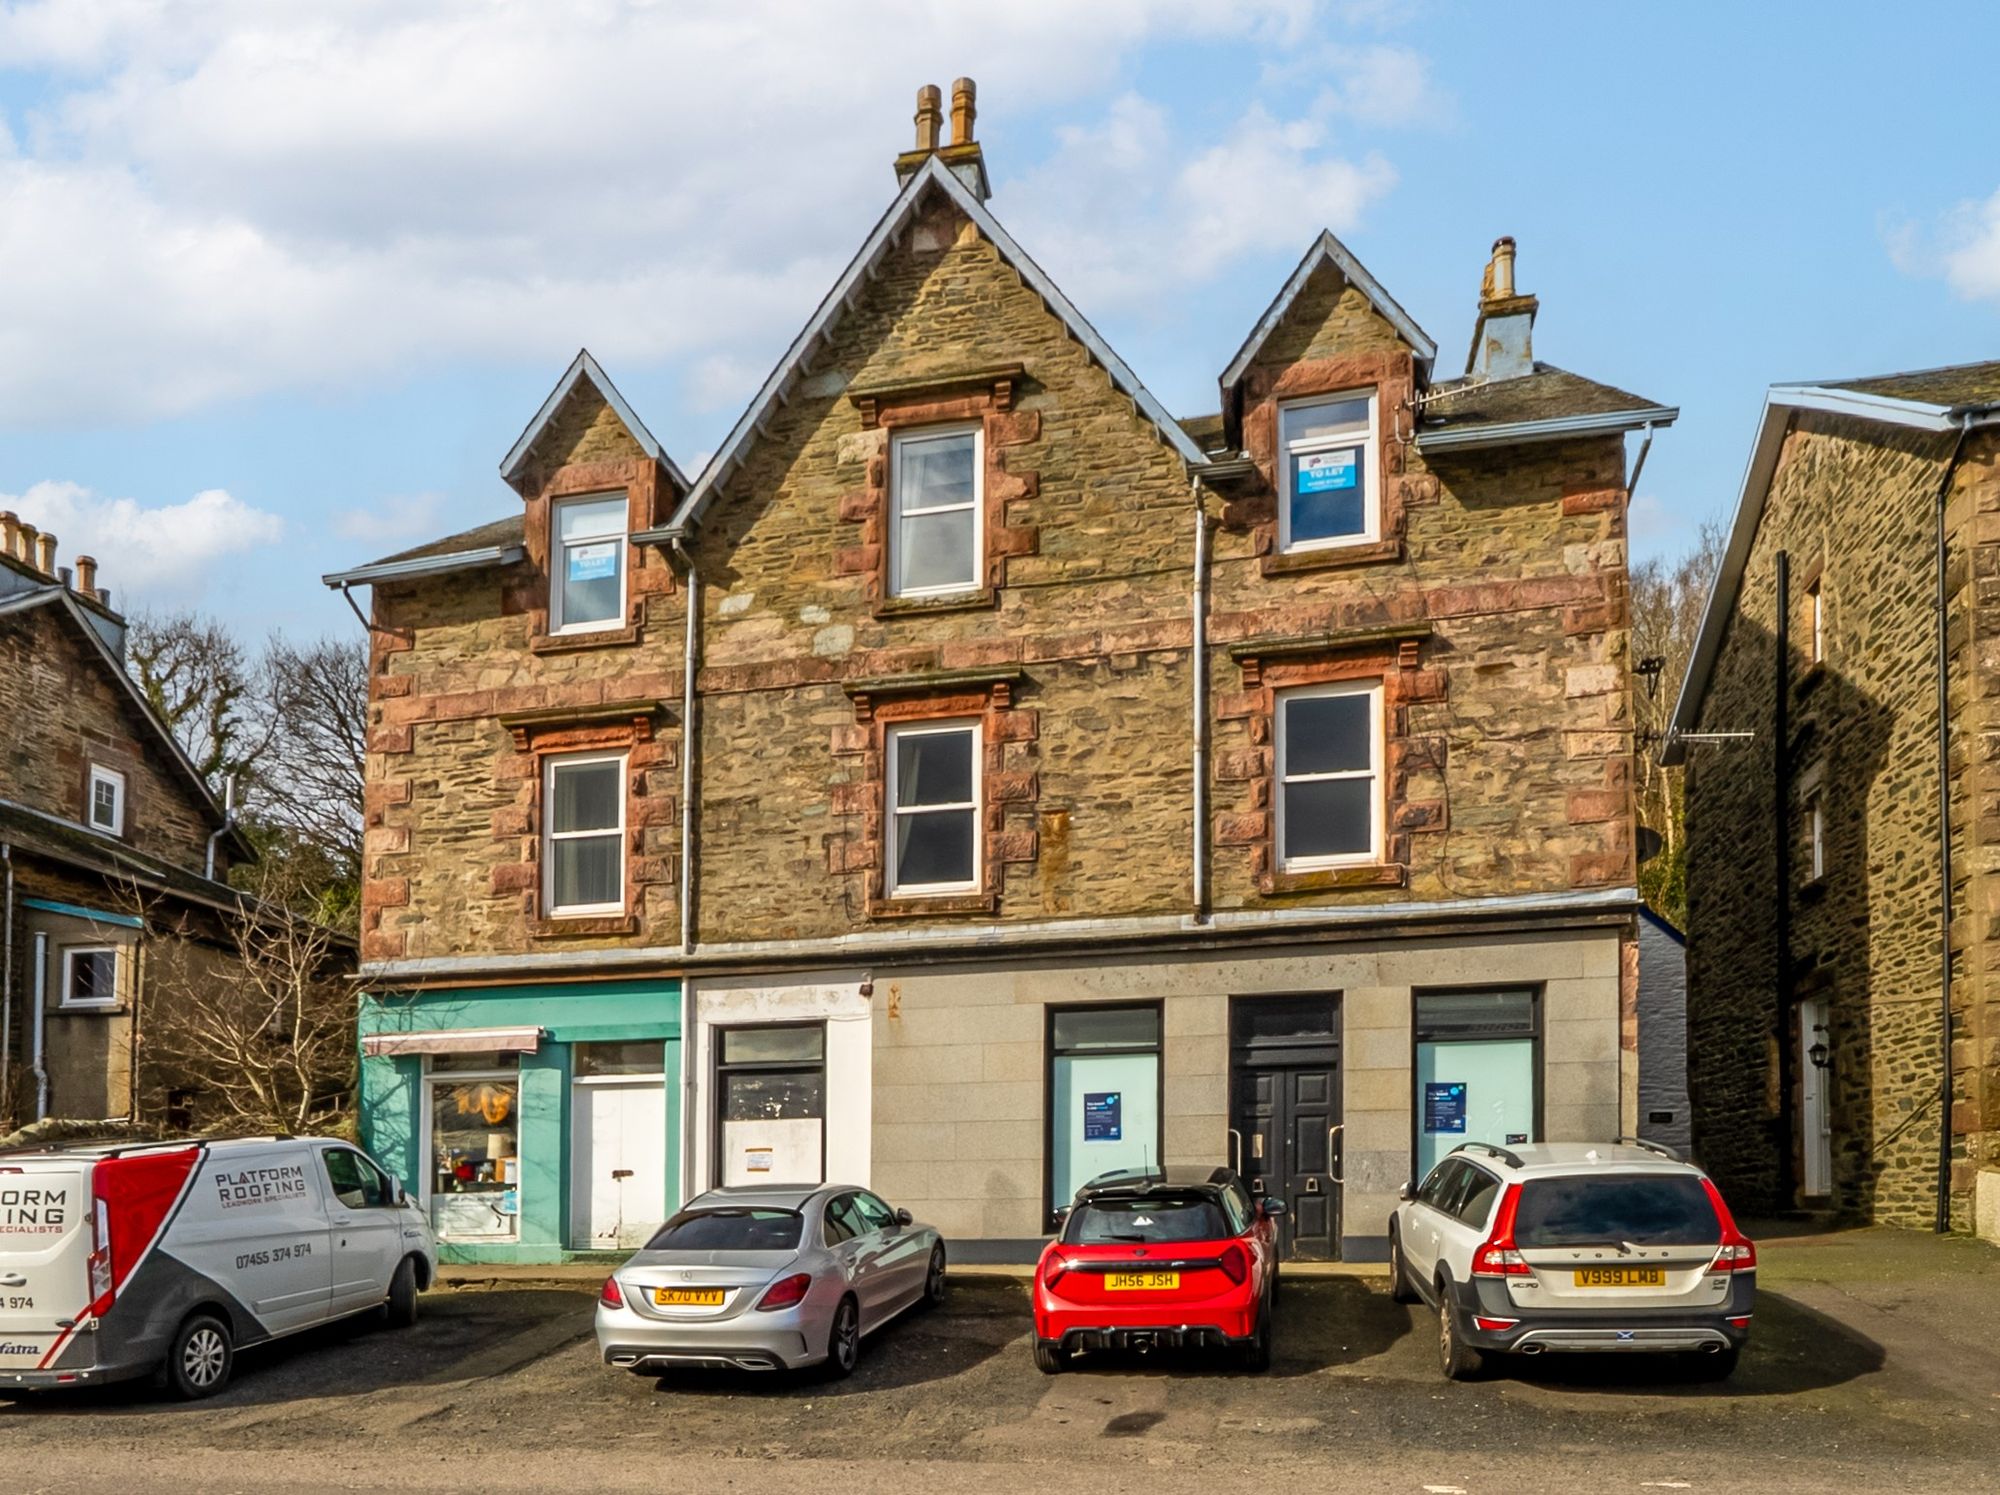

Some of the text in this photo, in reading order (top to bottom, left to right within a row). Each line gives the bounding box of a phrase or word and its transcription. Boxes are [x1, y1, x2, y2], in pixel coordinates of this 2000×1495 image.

[215, 1166, 303, 1187] PLATFORM
[219, 1180, 305, 1202] ROOFING
[236, 1243, 312, 1270] 07455 374 974
[1572, 1251, 1669, 1259] VOLVO
[1111, 1273, 1173, 1287] JH56 JSH
[1580, 1270, 1622, 1284] V999
[660, 1288, 691, 1302] SK70
[10, 1297, 33, 1309] 974
